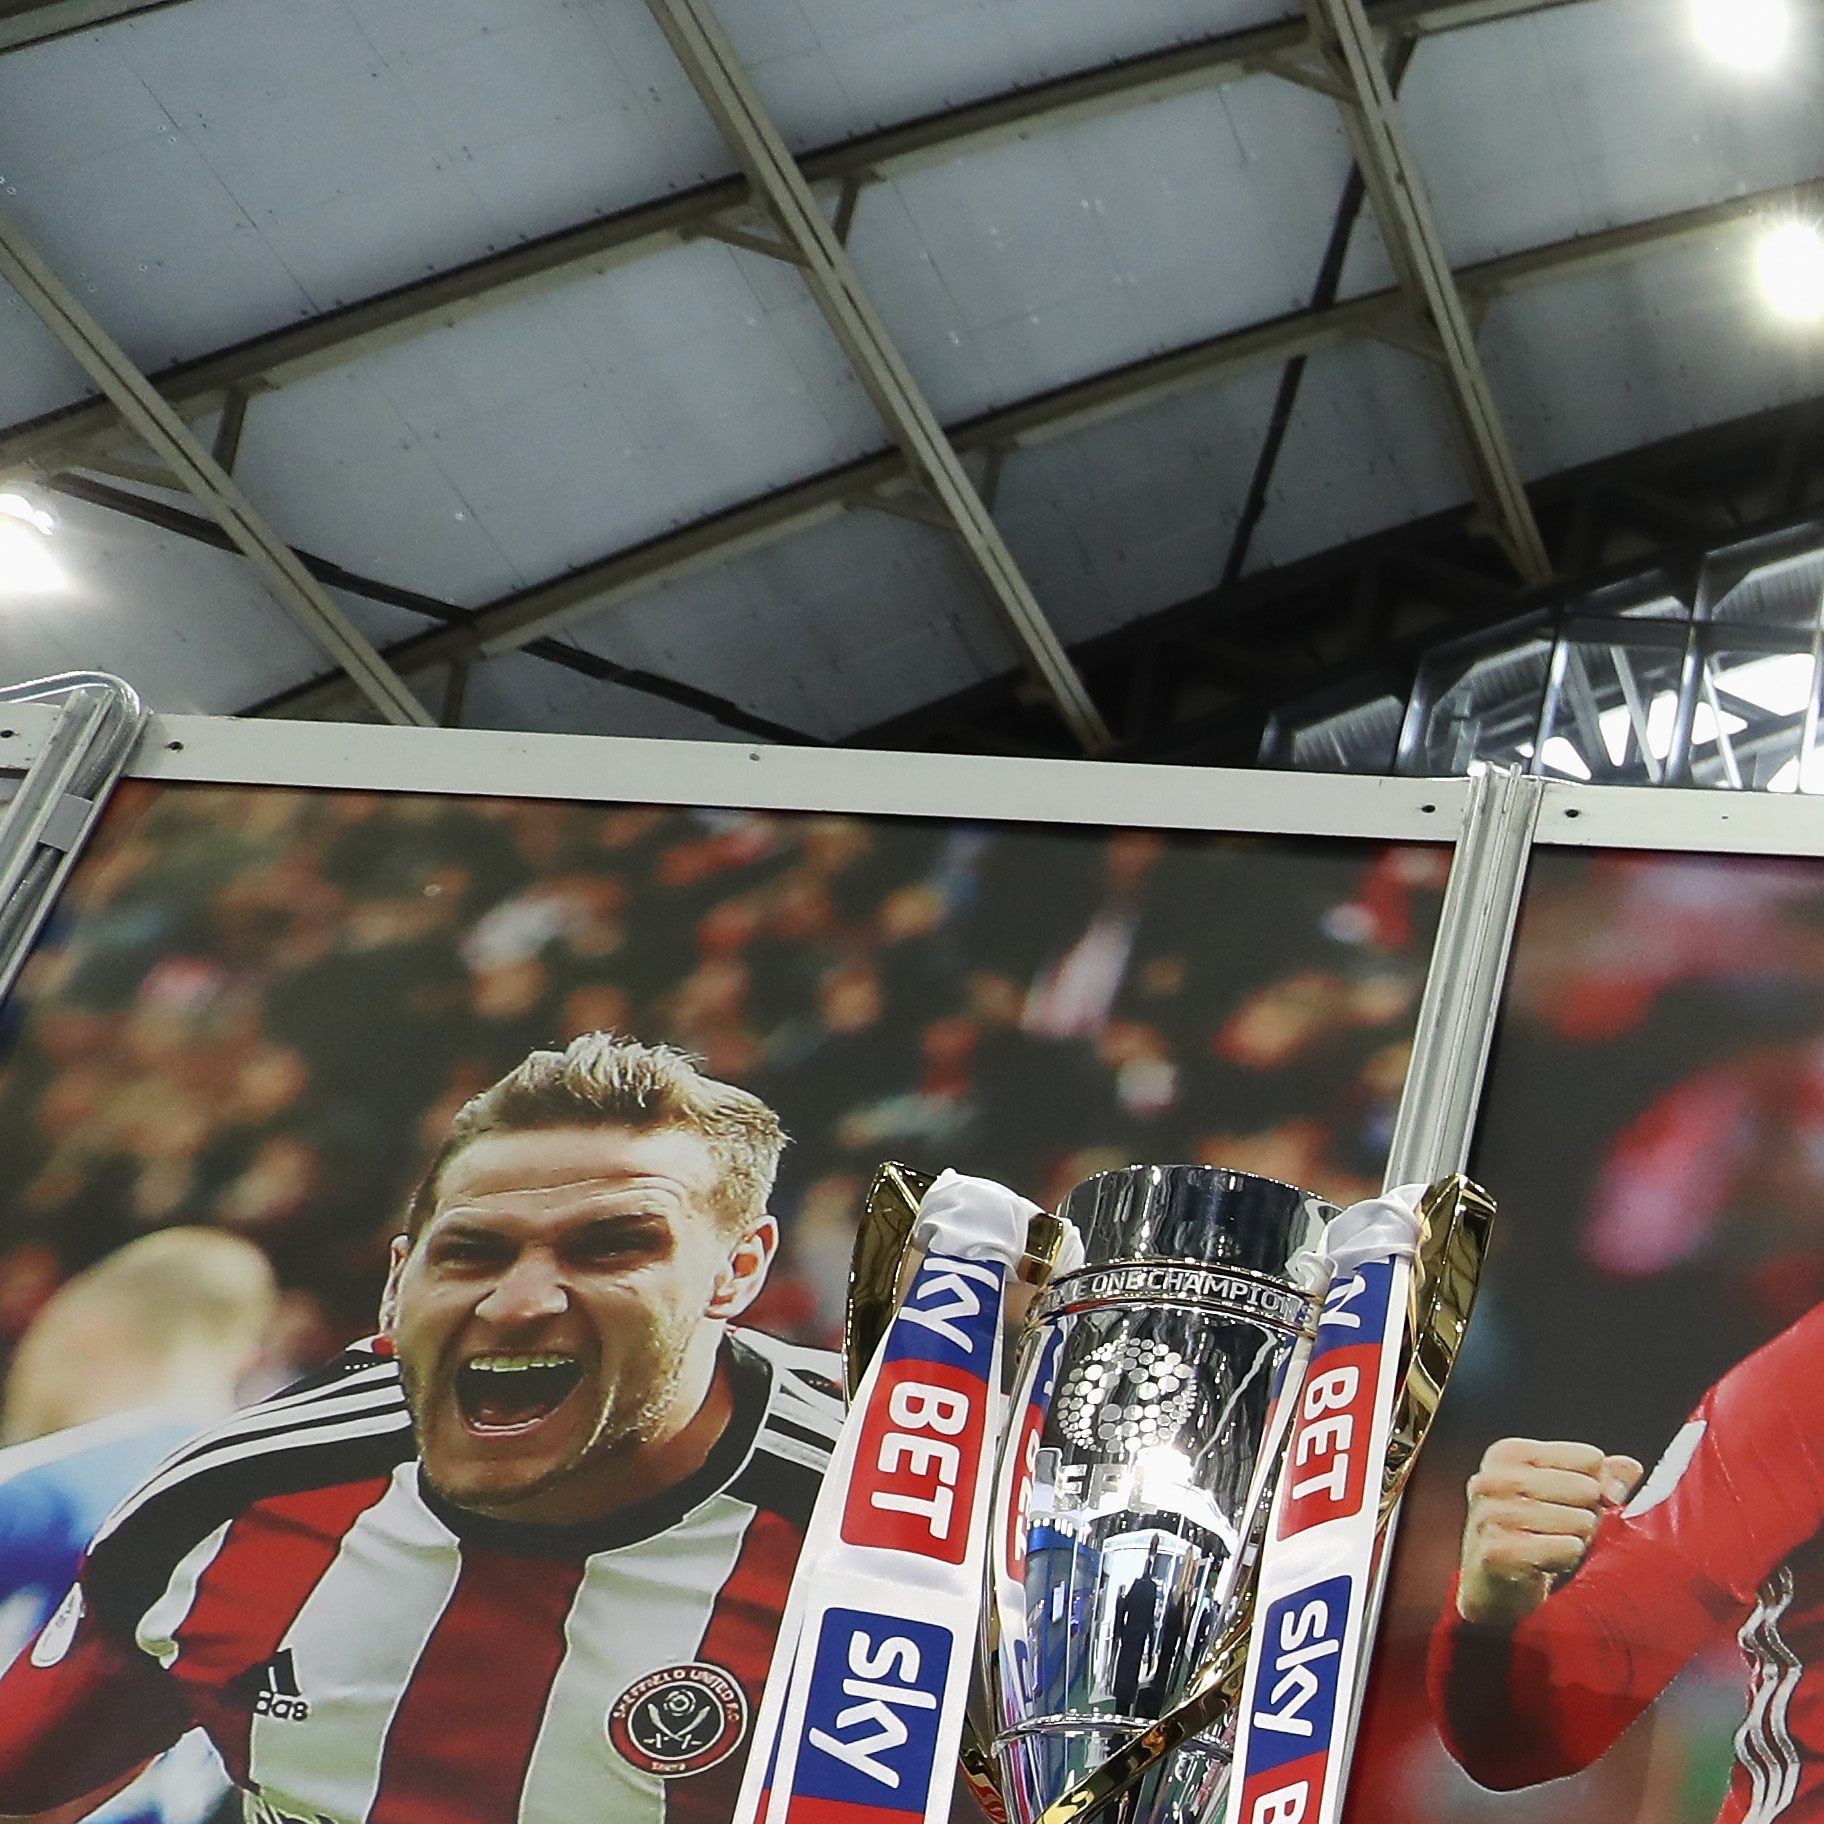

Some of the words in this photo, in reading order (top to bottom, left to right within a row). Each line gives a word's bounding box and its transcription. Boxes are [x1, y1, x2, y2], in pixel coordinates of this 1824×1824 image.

[899, 1255, 1000, 1355] ky
[1091, 1275, 1140, 1294] ONE
[871, 1381, 970, 1541] BET
[1296, 1364, 1360, 1502] BET
[809, 1629, 937, 1790] sky
[1255, 1599, 1338, 1737] sky
